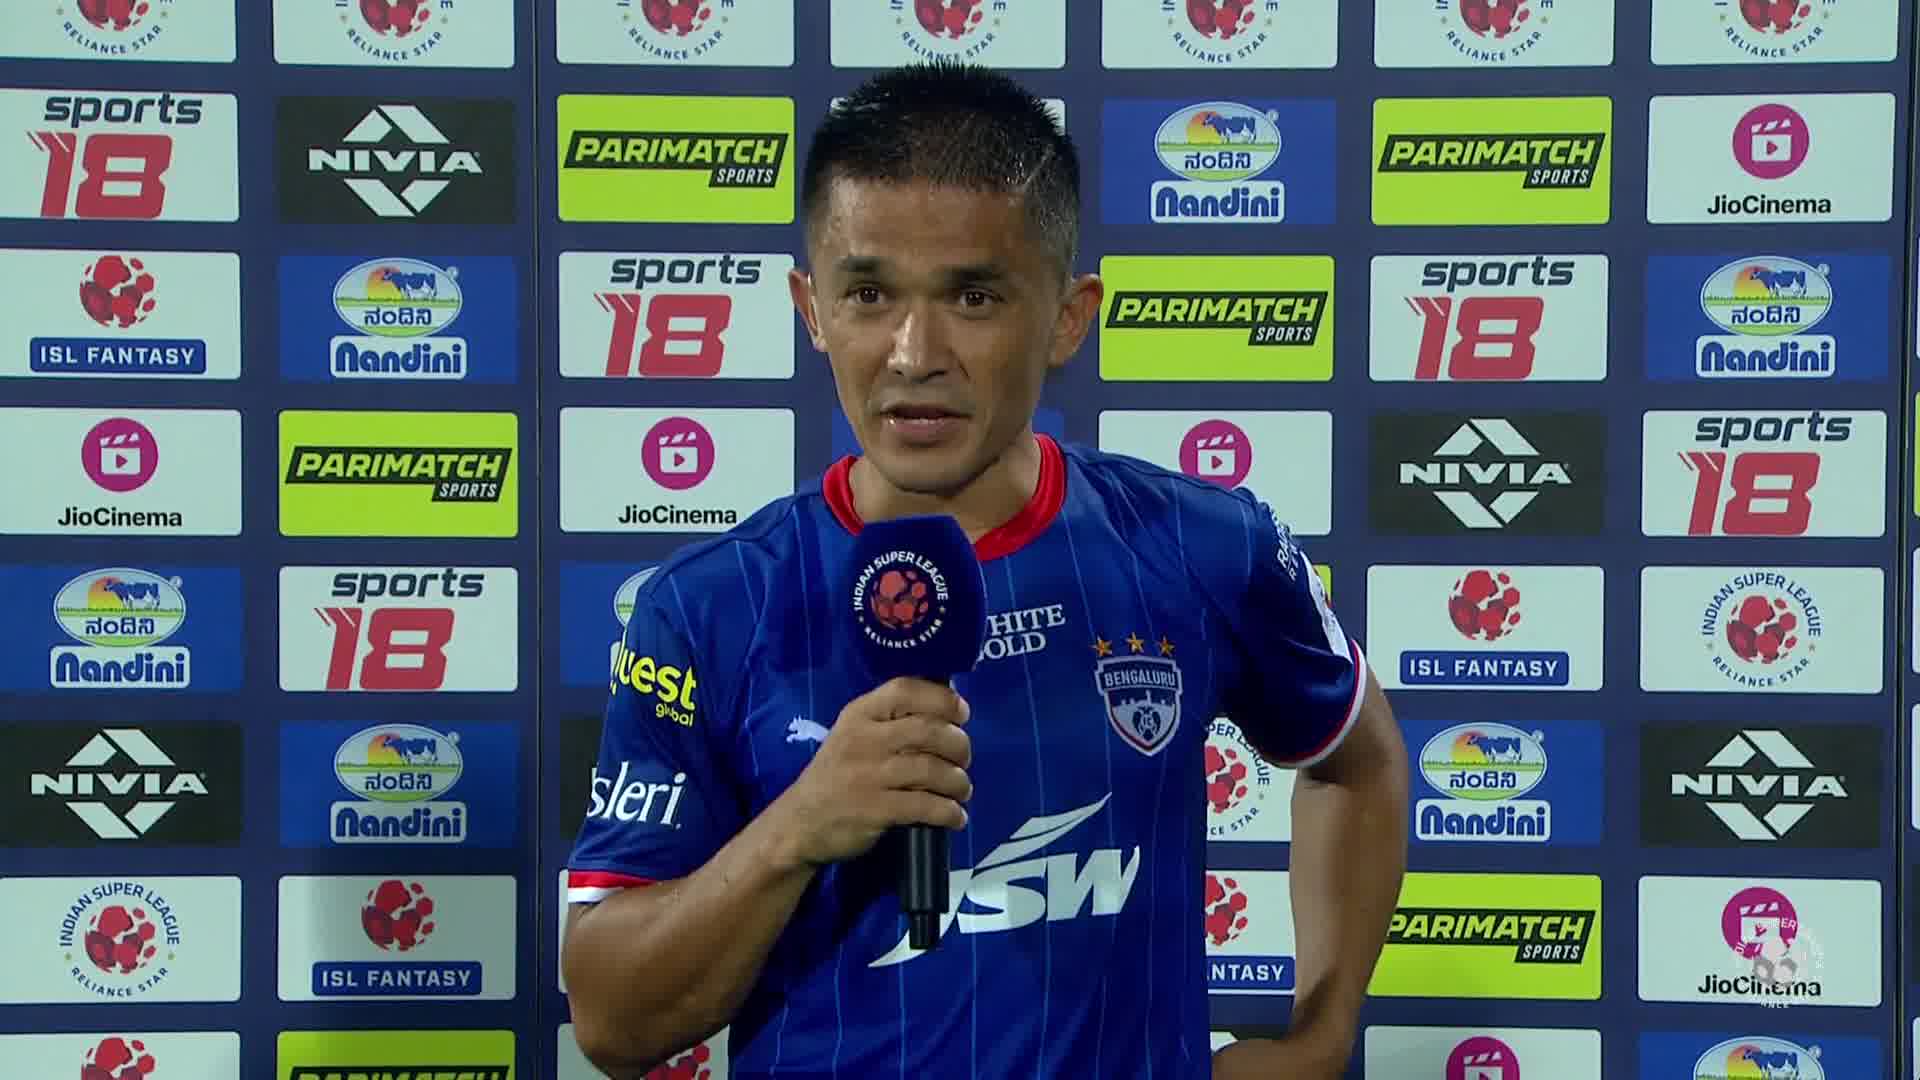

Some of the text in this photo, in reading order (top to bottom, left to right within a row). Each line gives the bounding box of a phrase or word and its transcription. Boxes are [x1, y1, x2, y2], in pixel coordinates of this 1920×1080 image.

[63, 22, 163, 54] RELIANCE STAR
[346, 28, 442, 60] RELIANCE STAR
[628, 27, 723, 60] RELIANCE STAR
[1174, 32, 1267, 63] RELIANCE STAR
[1446, 31, 1543, 61] RELIANCE STAR
[1724, 26, 1823, 57] RELIANCE STAR
[44, 93, 203, 129] sports
[309, 149, 483, 174] NIVIA
[576, 137, 776, 165] PARIMATCH
[1389, 140, 1596, 166] PARIMATCH
[26, 131, 173, 219] 18
[717, 168, 774, 184] SPORTS
[1531, 169, 1589, 185] SPORTS
[1156, 185, 1279, 218] Nandini
[1707, 195, 1831, 215] JioCinema
[610, 255, 761, 290] sports
[1421, 256, 1575, 293] sports
[1116, 297, 1320, 323] PARIMATCH
[594, 293, 732, 377] 18
[1255, 326, 1313, 342] SPORTS
[1404, 296, 1545, 381] 18
[40, 347, 195, 365] ISL FANTASY
[335, 343, 461, 375] Nandini
[1700, 341, 1831, 372] Nandini
[1695, 411, 1852, 448] sports
[295, 452, 502, 479] PARIMATCH
[1400, 463, 1573, 484] NIVIA
[439, 483, 496, 498] SPORTS
[1677, 452, 1821, 536] 18
[58, 507, 183, 528] JioCinema
[618, 505, 737, 524] JioCinema
[332, 568, 484, 603] sports
[853, 551, 948, 611] INDIAN SUPER LEAGUE
[987, 604, 1066, 636] HITE
[1702, 572, 1821, 637] INDIAN SUPER LEAGUE
[314, 607, 455, 691] 18
[976, 631, 1046, 661] OLD
[56, 653, 185, 684] Nandini
[612, 642, 697, 711] uest
[1104, 669, 1176, 687] BENGALURU
[1409, 660, 1559, 677] ISL FANTASY
[1712, 655, 1809, 688] RELIANCE STAR
[1207, 723, 1236, 738] PER
[31, 773, 208, 796] NIVIA
[586, 760, 687, 826] sleri
[1672, 774, 1848, 797] NIVIA
[336, 808, 460, 838] Nandini
[1230, 807, 1260, 831] STAR
[1421, 804, 1546, 837] Nandini
[59, 882, 180, 947] INDIAN SUPER LEAGUE
[1386, 914, 1585, 941] PARIMATCH
[1522, 944, 1581, 960] SPORTS
[71, 966, 168, 997] RELIANCE STAR
[322, 970, 471, 988] ISL FANTASY
[1207, 964, 1284, 981] NTASY
